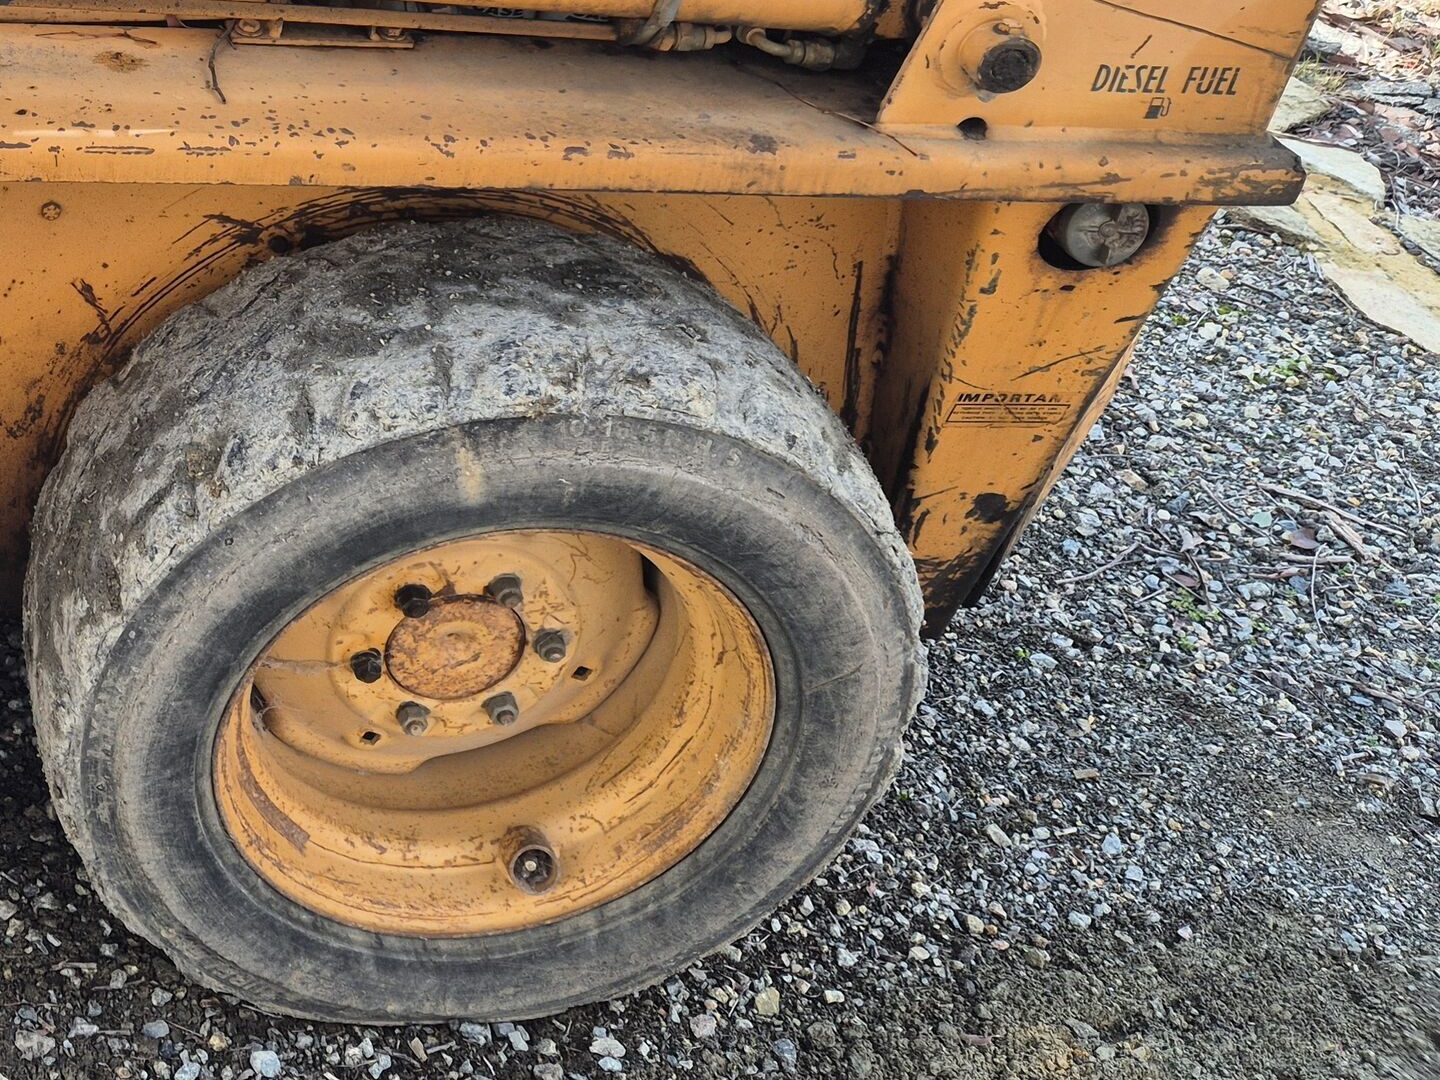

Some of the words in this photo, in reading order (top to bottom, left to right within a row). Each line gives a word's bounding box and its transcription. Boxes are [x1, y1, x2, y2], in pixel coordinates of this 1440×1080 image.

[1090, 63, 1169, 94] DIESEL
[1181, 66, 1241, 96] FUEL
[957, 392, 1071, 403] IMPORTAN
